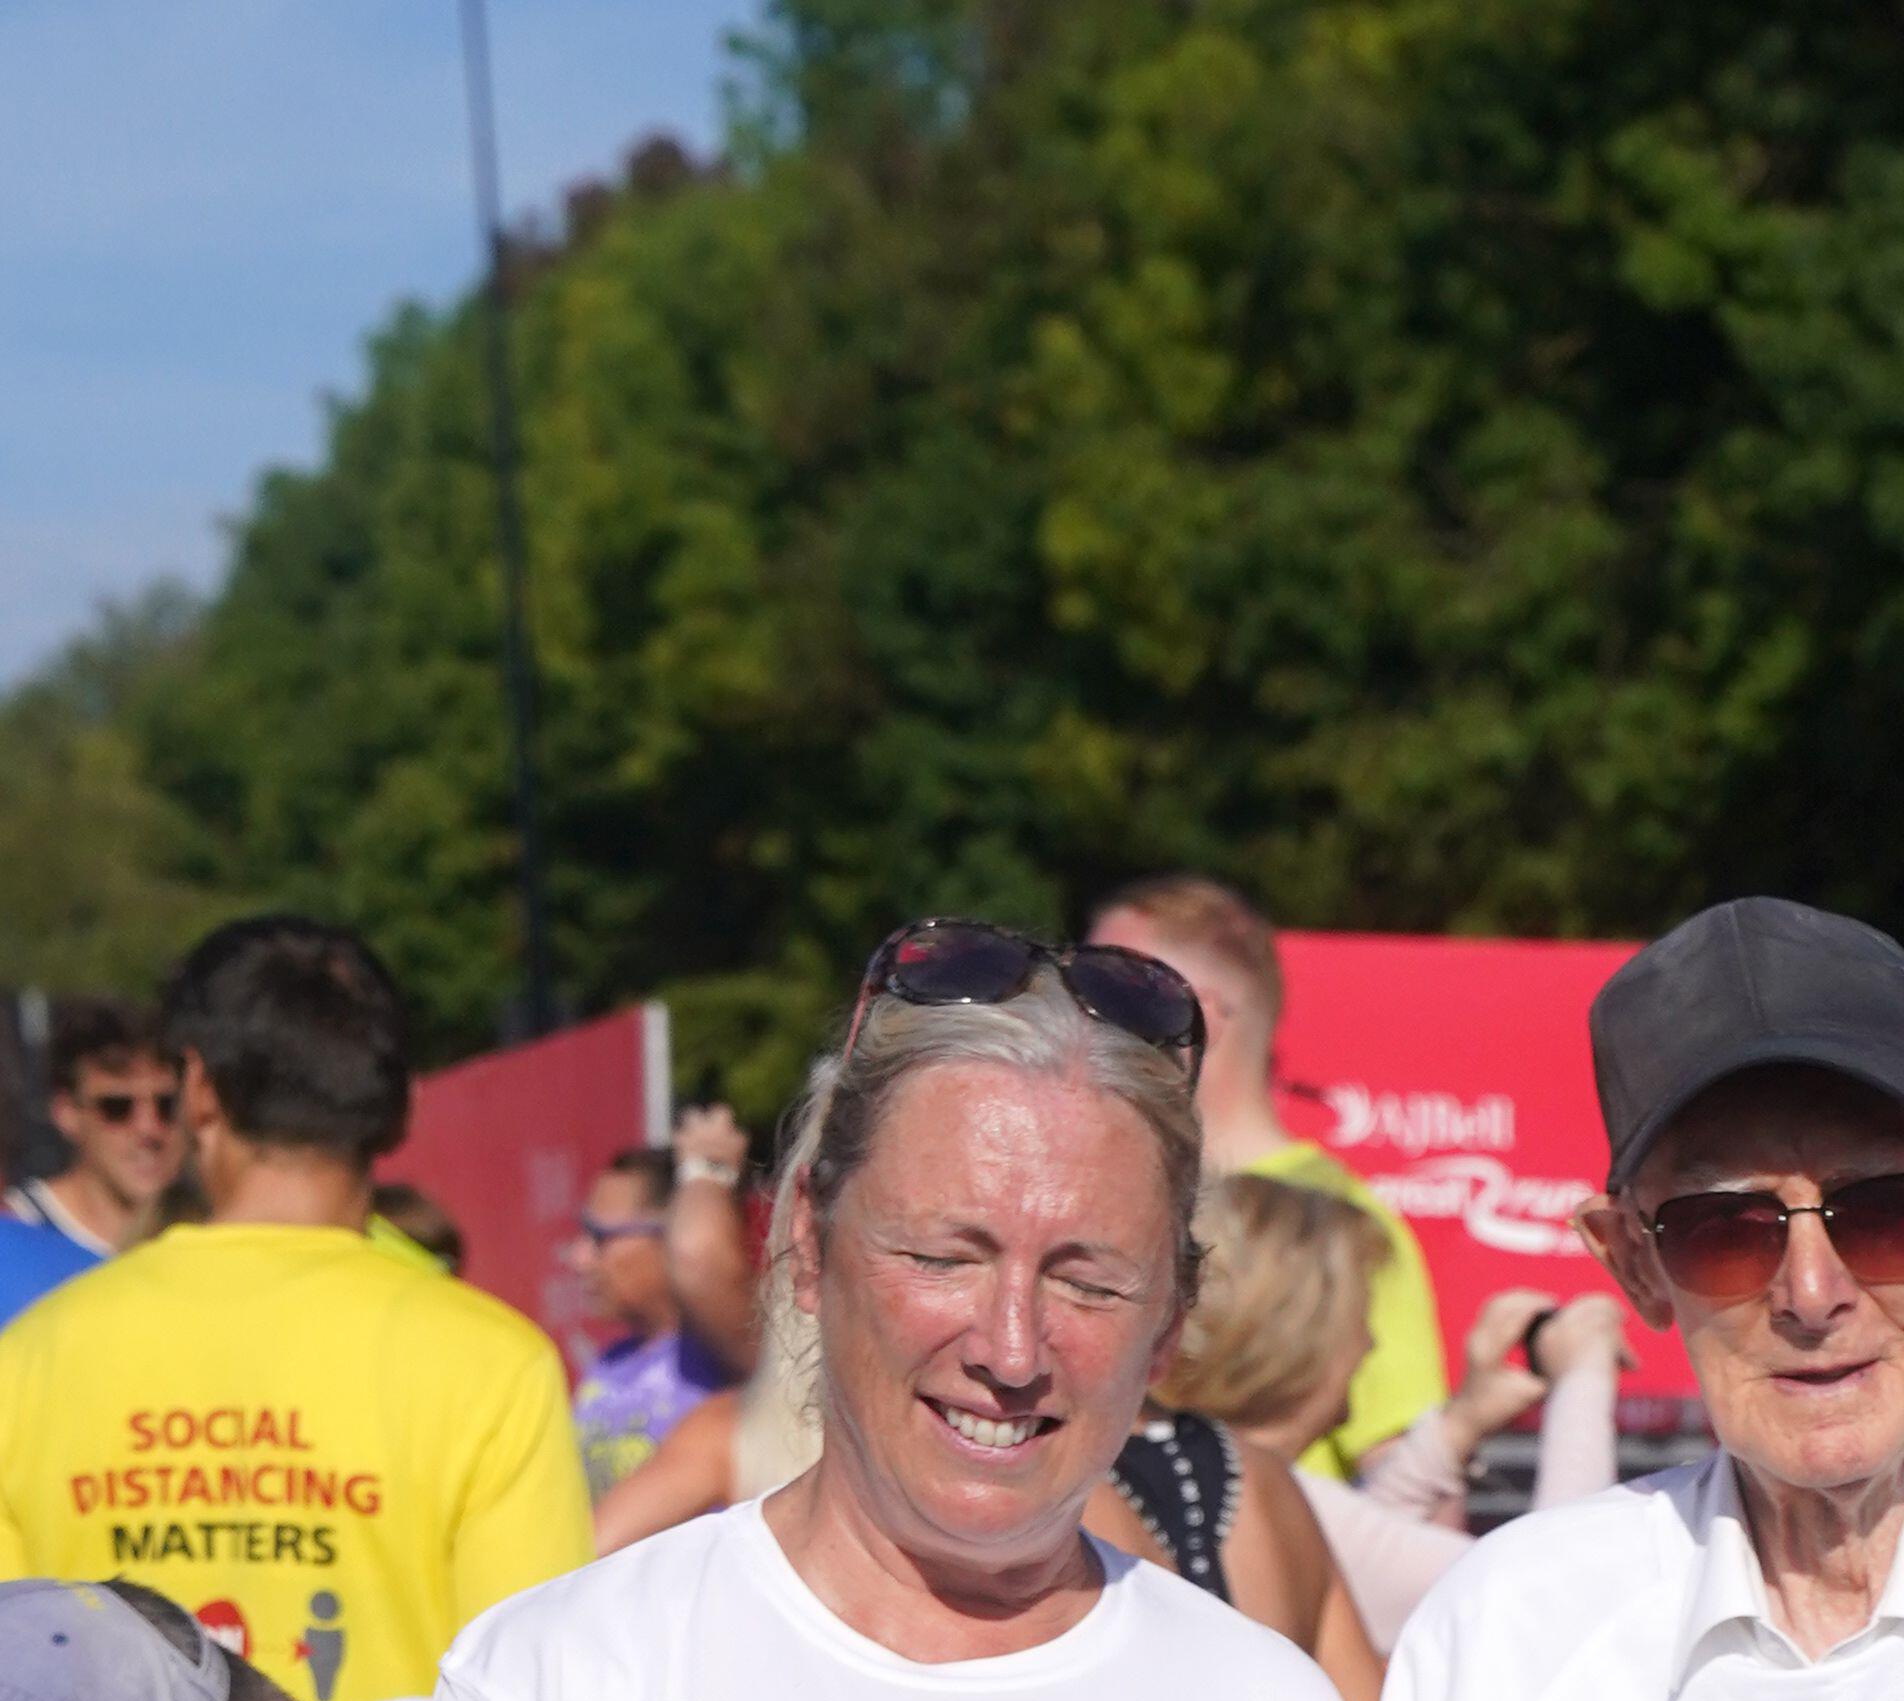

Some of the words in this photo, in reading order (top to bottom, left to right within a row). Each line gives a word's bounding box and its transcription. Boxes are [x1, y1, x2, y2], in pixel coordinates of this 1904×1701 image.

[127, 1408, 312, 1452] SOCIAL
[70, 1463, 383, 1517] DISTANCING
[110, 1521, 337, 1566] MATTERS
